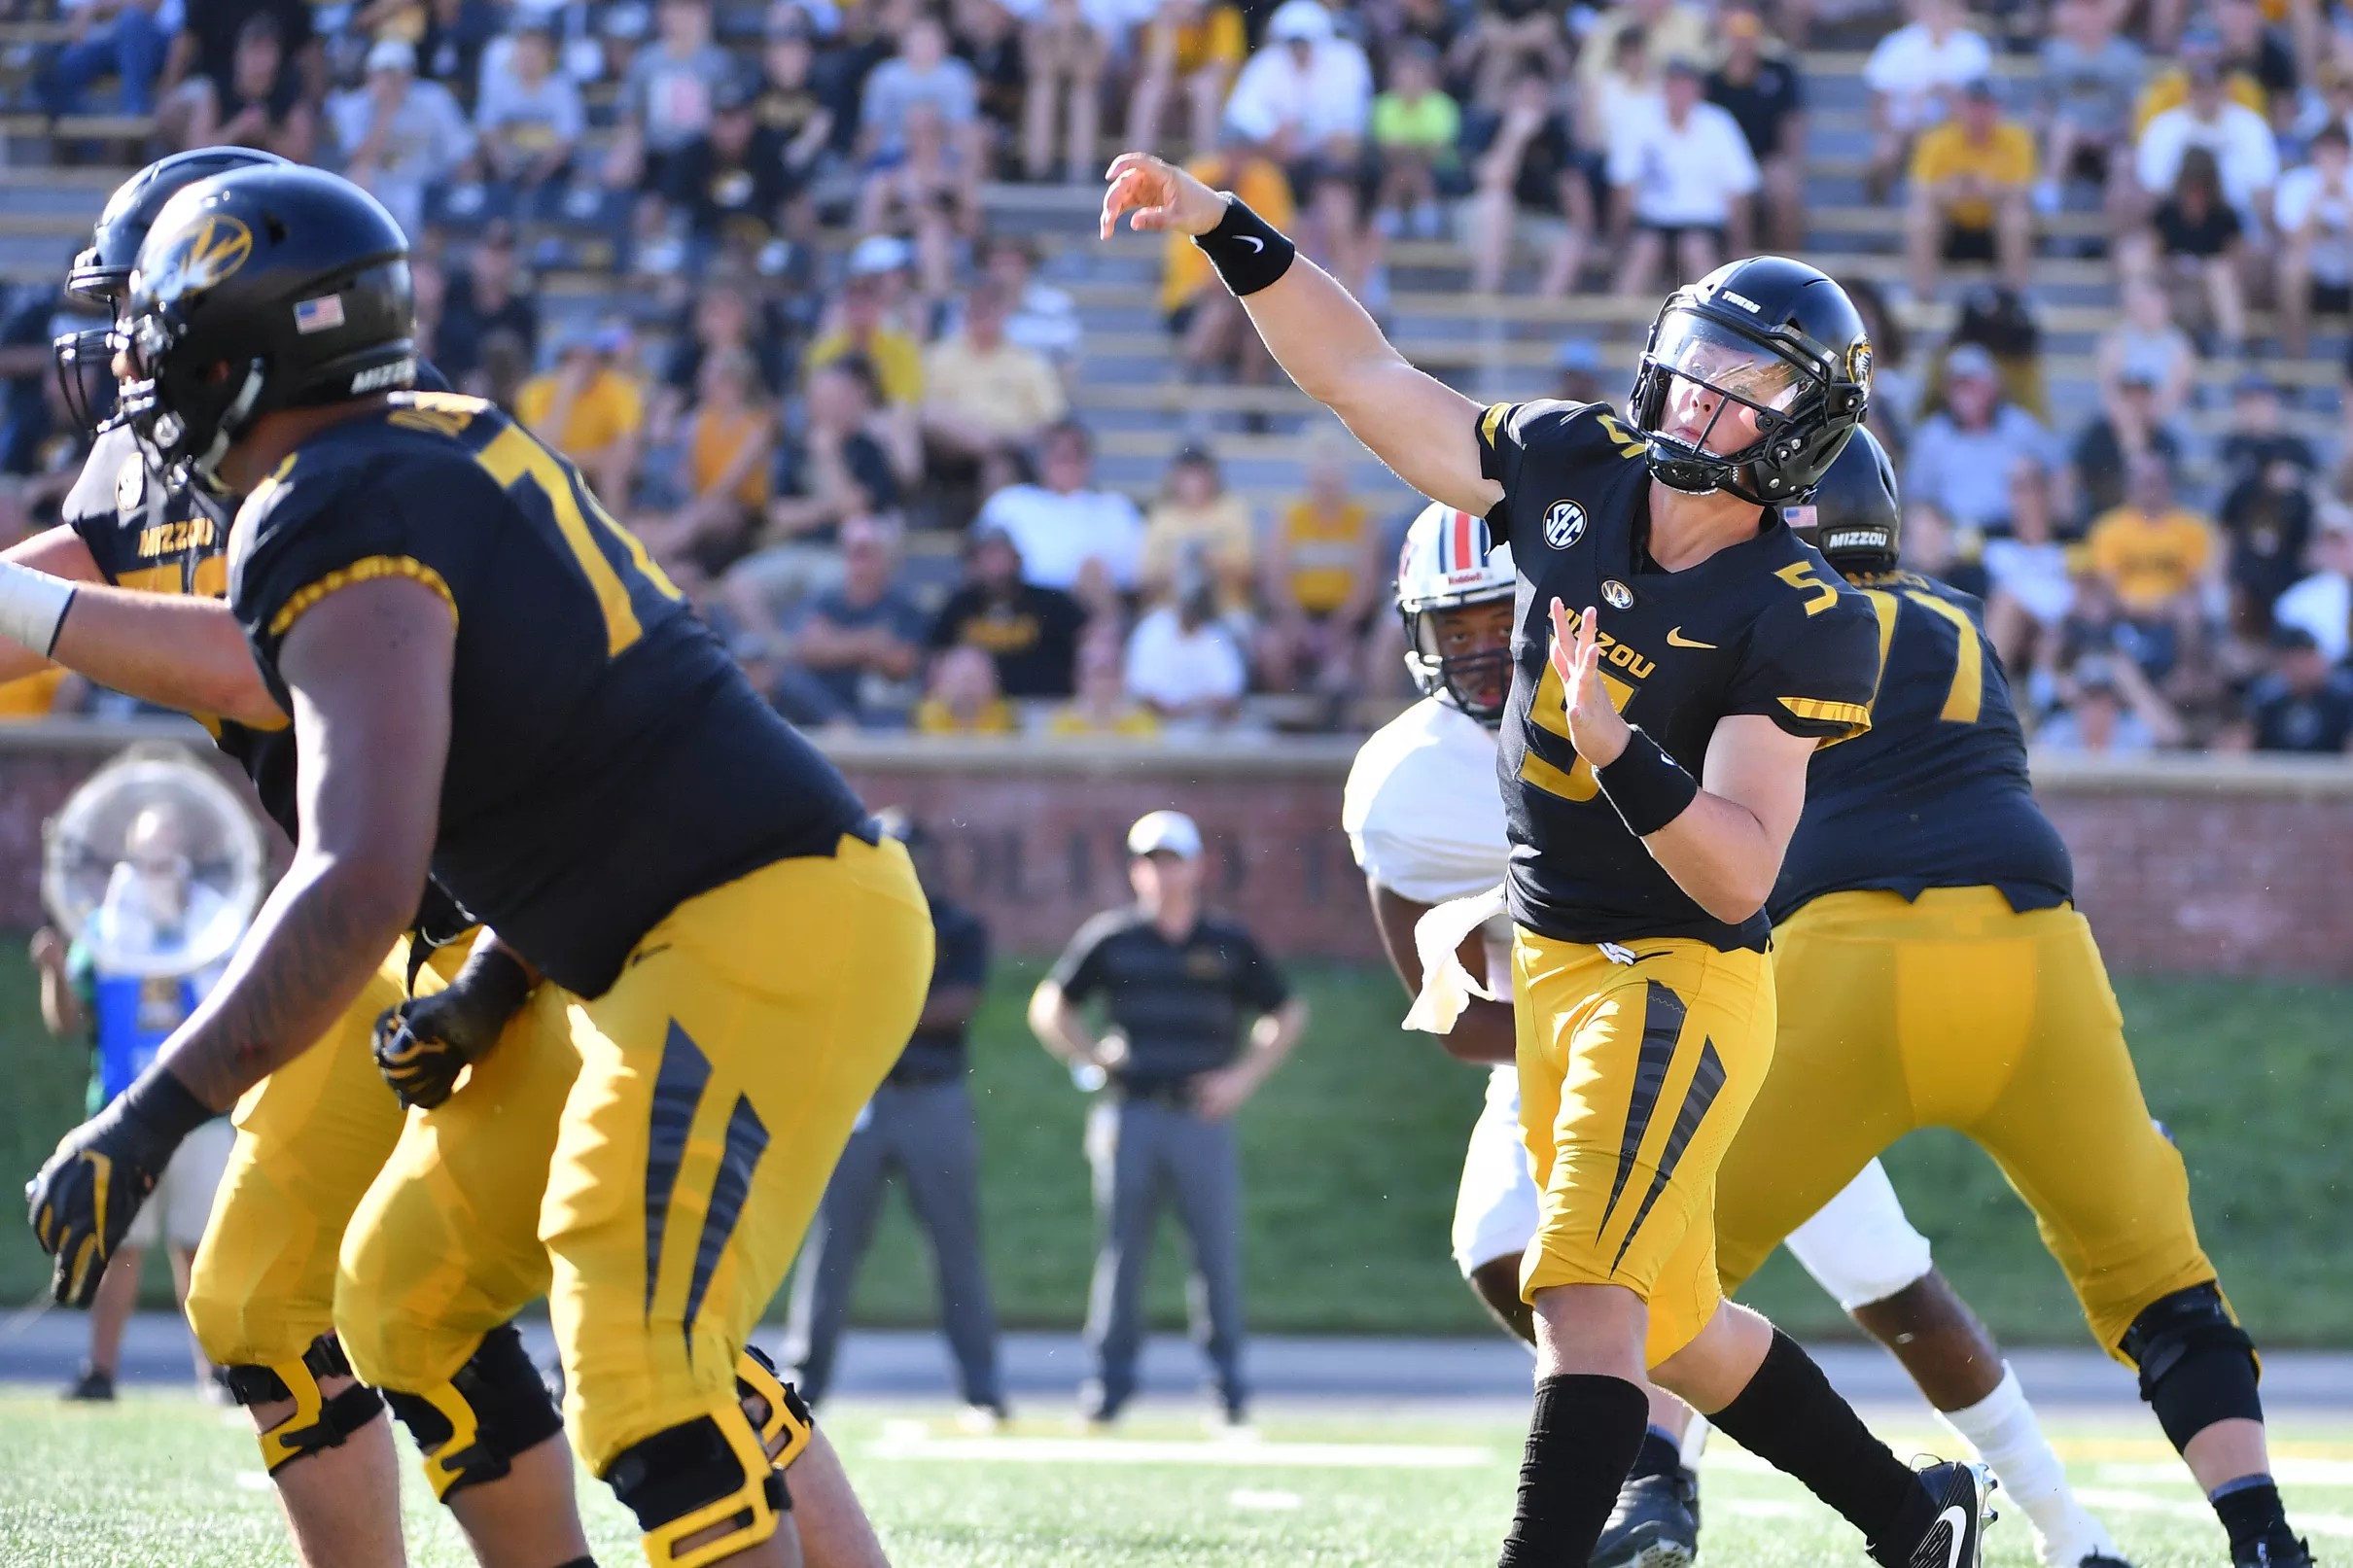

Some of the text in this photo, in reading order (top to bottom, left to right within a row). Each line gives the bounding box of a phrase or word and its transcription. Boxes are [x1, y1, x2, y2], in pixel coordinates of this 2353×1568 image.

[138, 517, 214, 558] MIZZOU
[1545, 503, 1585, 546] SEC
[1828, 531, 1888, 549] MIZZOU
[1773, 560, 1840, 618] 5
[1547, 608, 1658, 679] IZOU
[1517, 633, 1636, 804] 5
